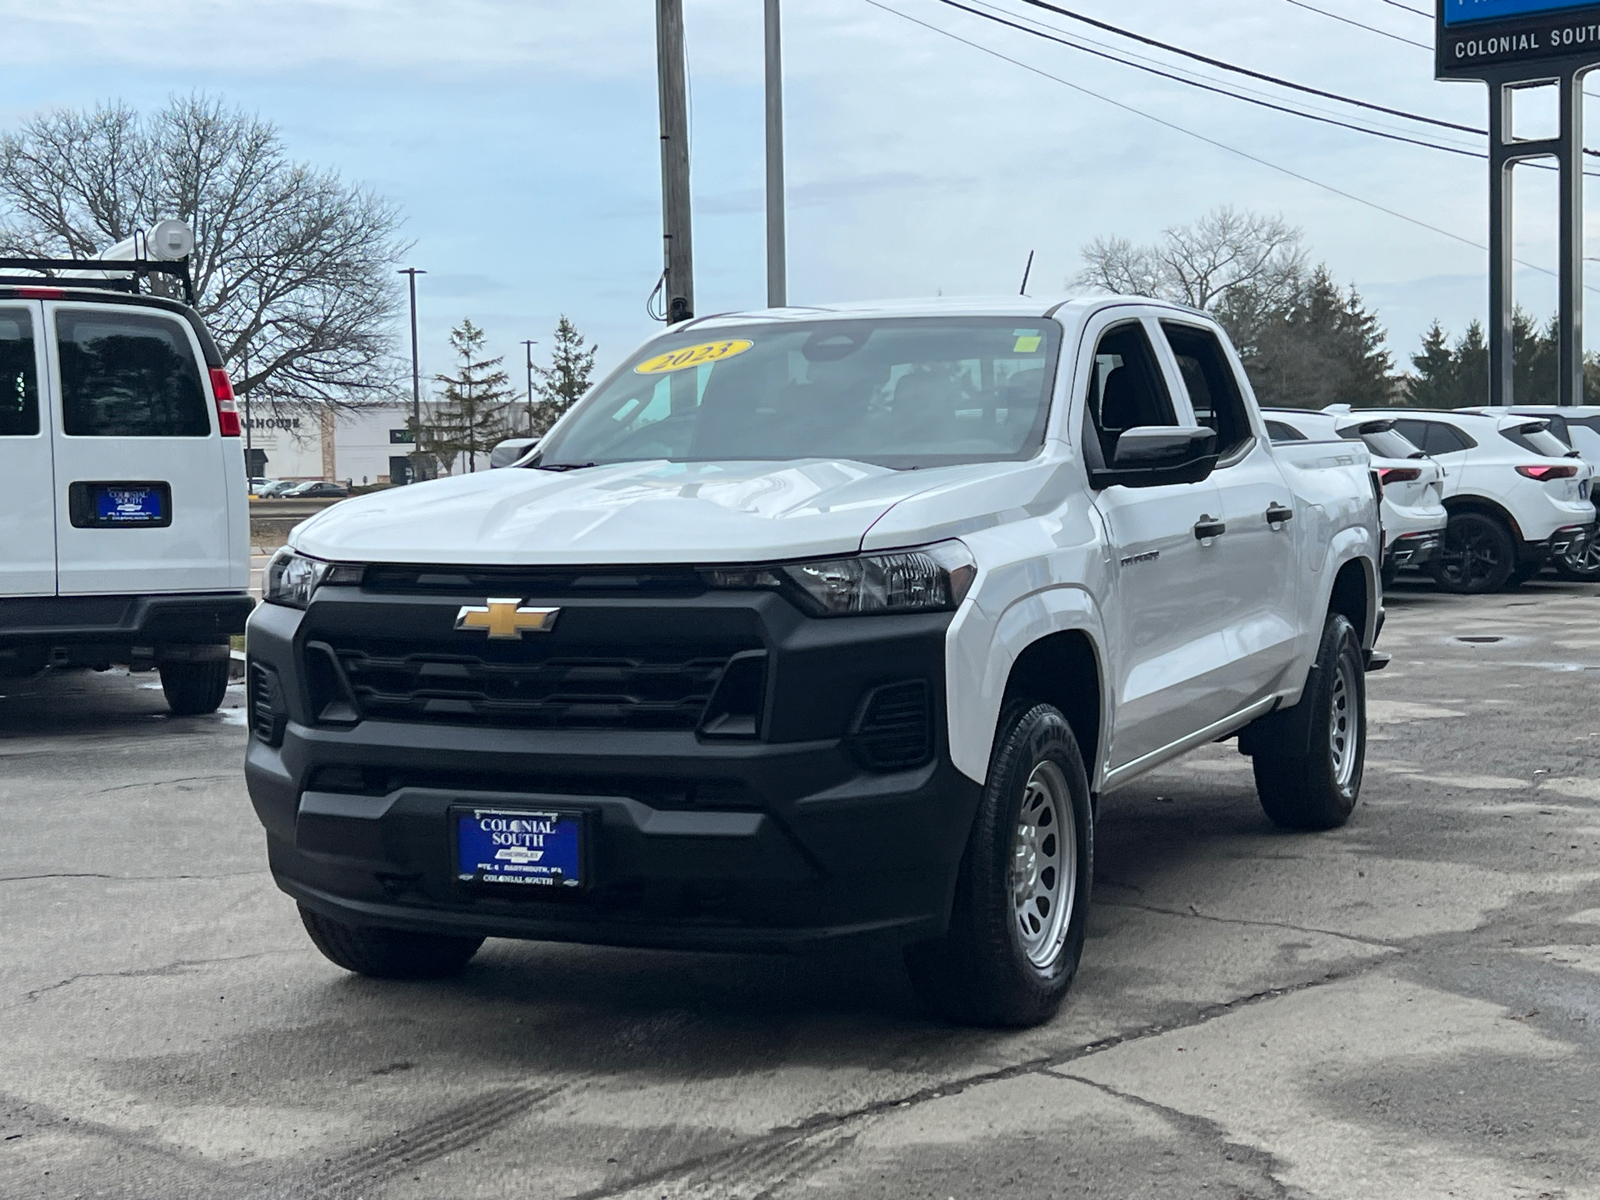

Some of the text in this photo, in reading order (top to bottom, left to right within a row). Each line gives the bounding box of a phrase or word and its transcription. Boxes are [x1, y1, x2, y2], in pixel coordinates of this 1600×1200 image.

[1455, 33, 1540, 58] COLONIAL
[650, 342, 734, 371] 2023
[480, 818, 556, 834] COLONIAL
[492, 832, 544, 847] SOUTH
[483, 874, 553, 886] COLONIAL SOUTH
